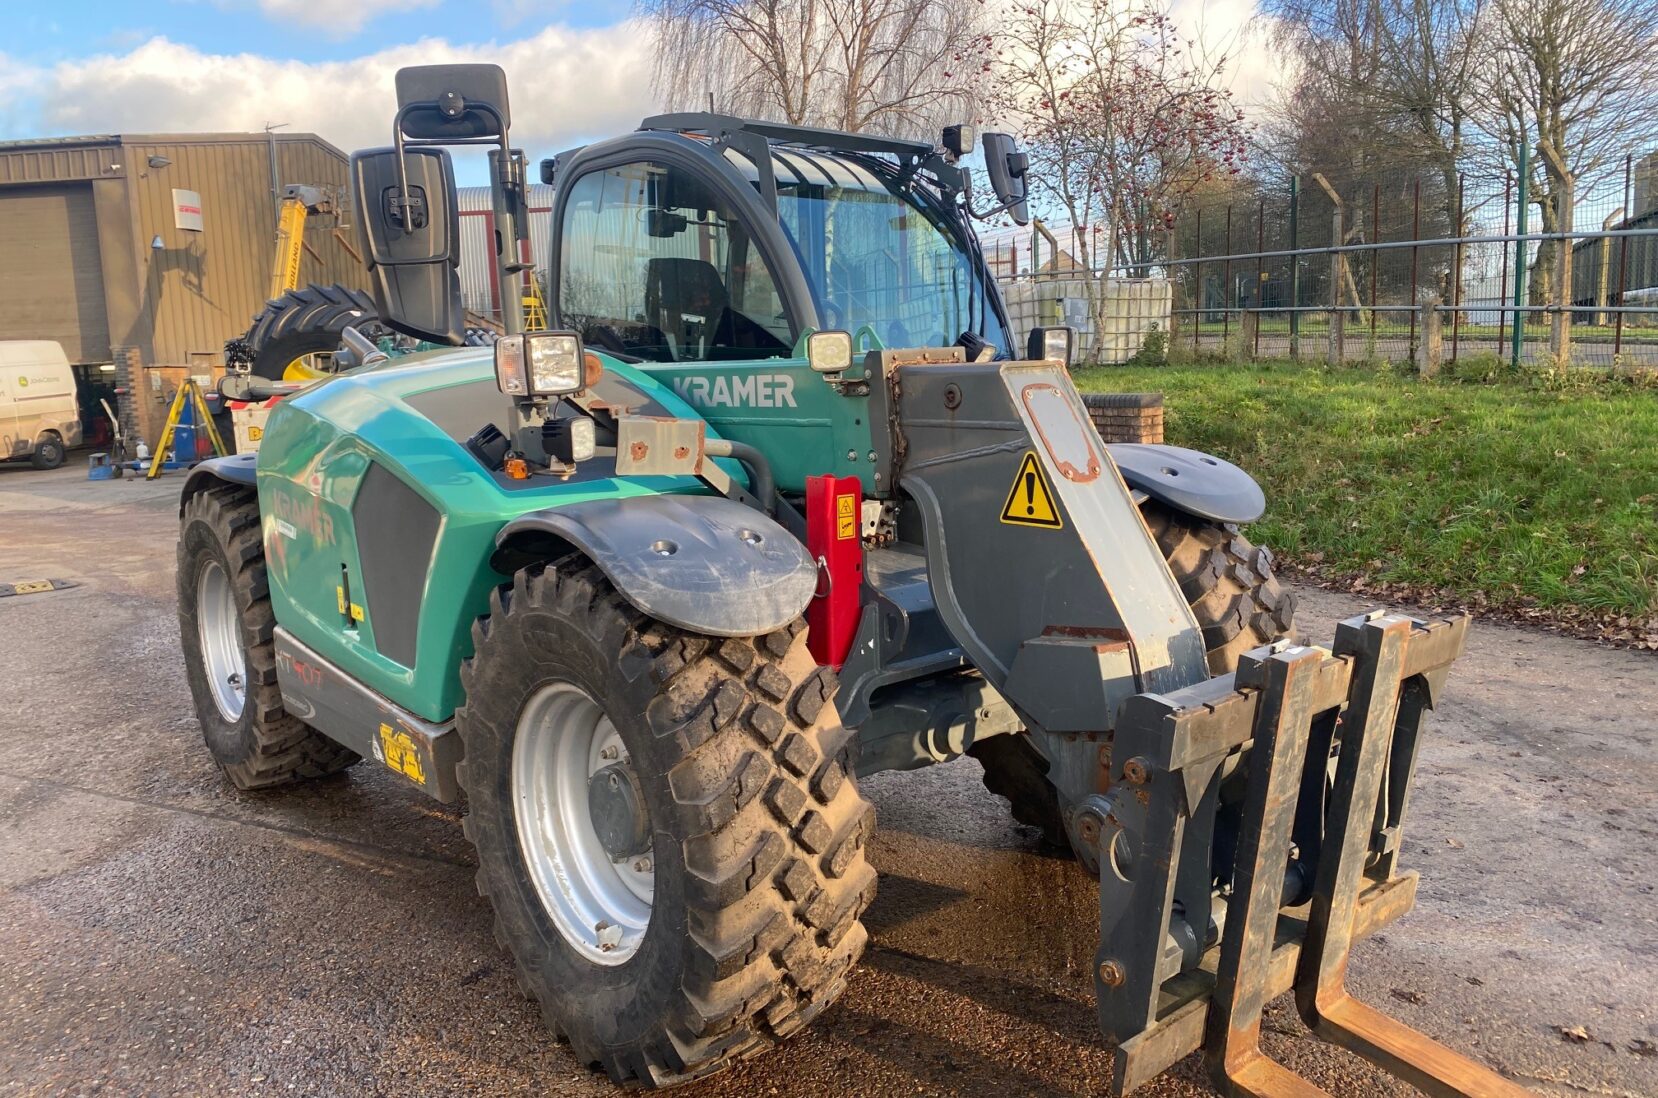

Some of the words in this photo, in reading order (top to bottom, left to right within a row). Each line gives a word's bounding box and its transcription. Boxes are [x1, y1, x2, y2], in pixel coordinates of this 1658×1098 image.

[673, 374, 798, 408] KRAMER
[272, 487, 337, 546] KRAMER
[292, 656, 321, 690] 407
